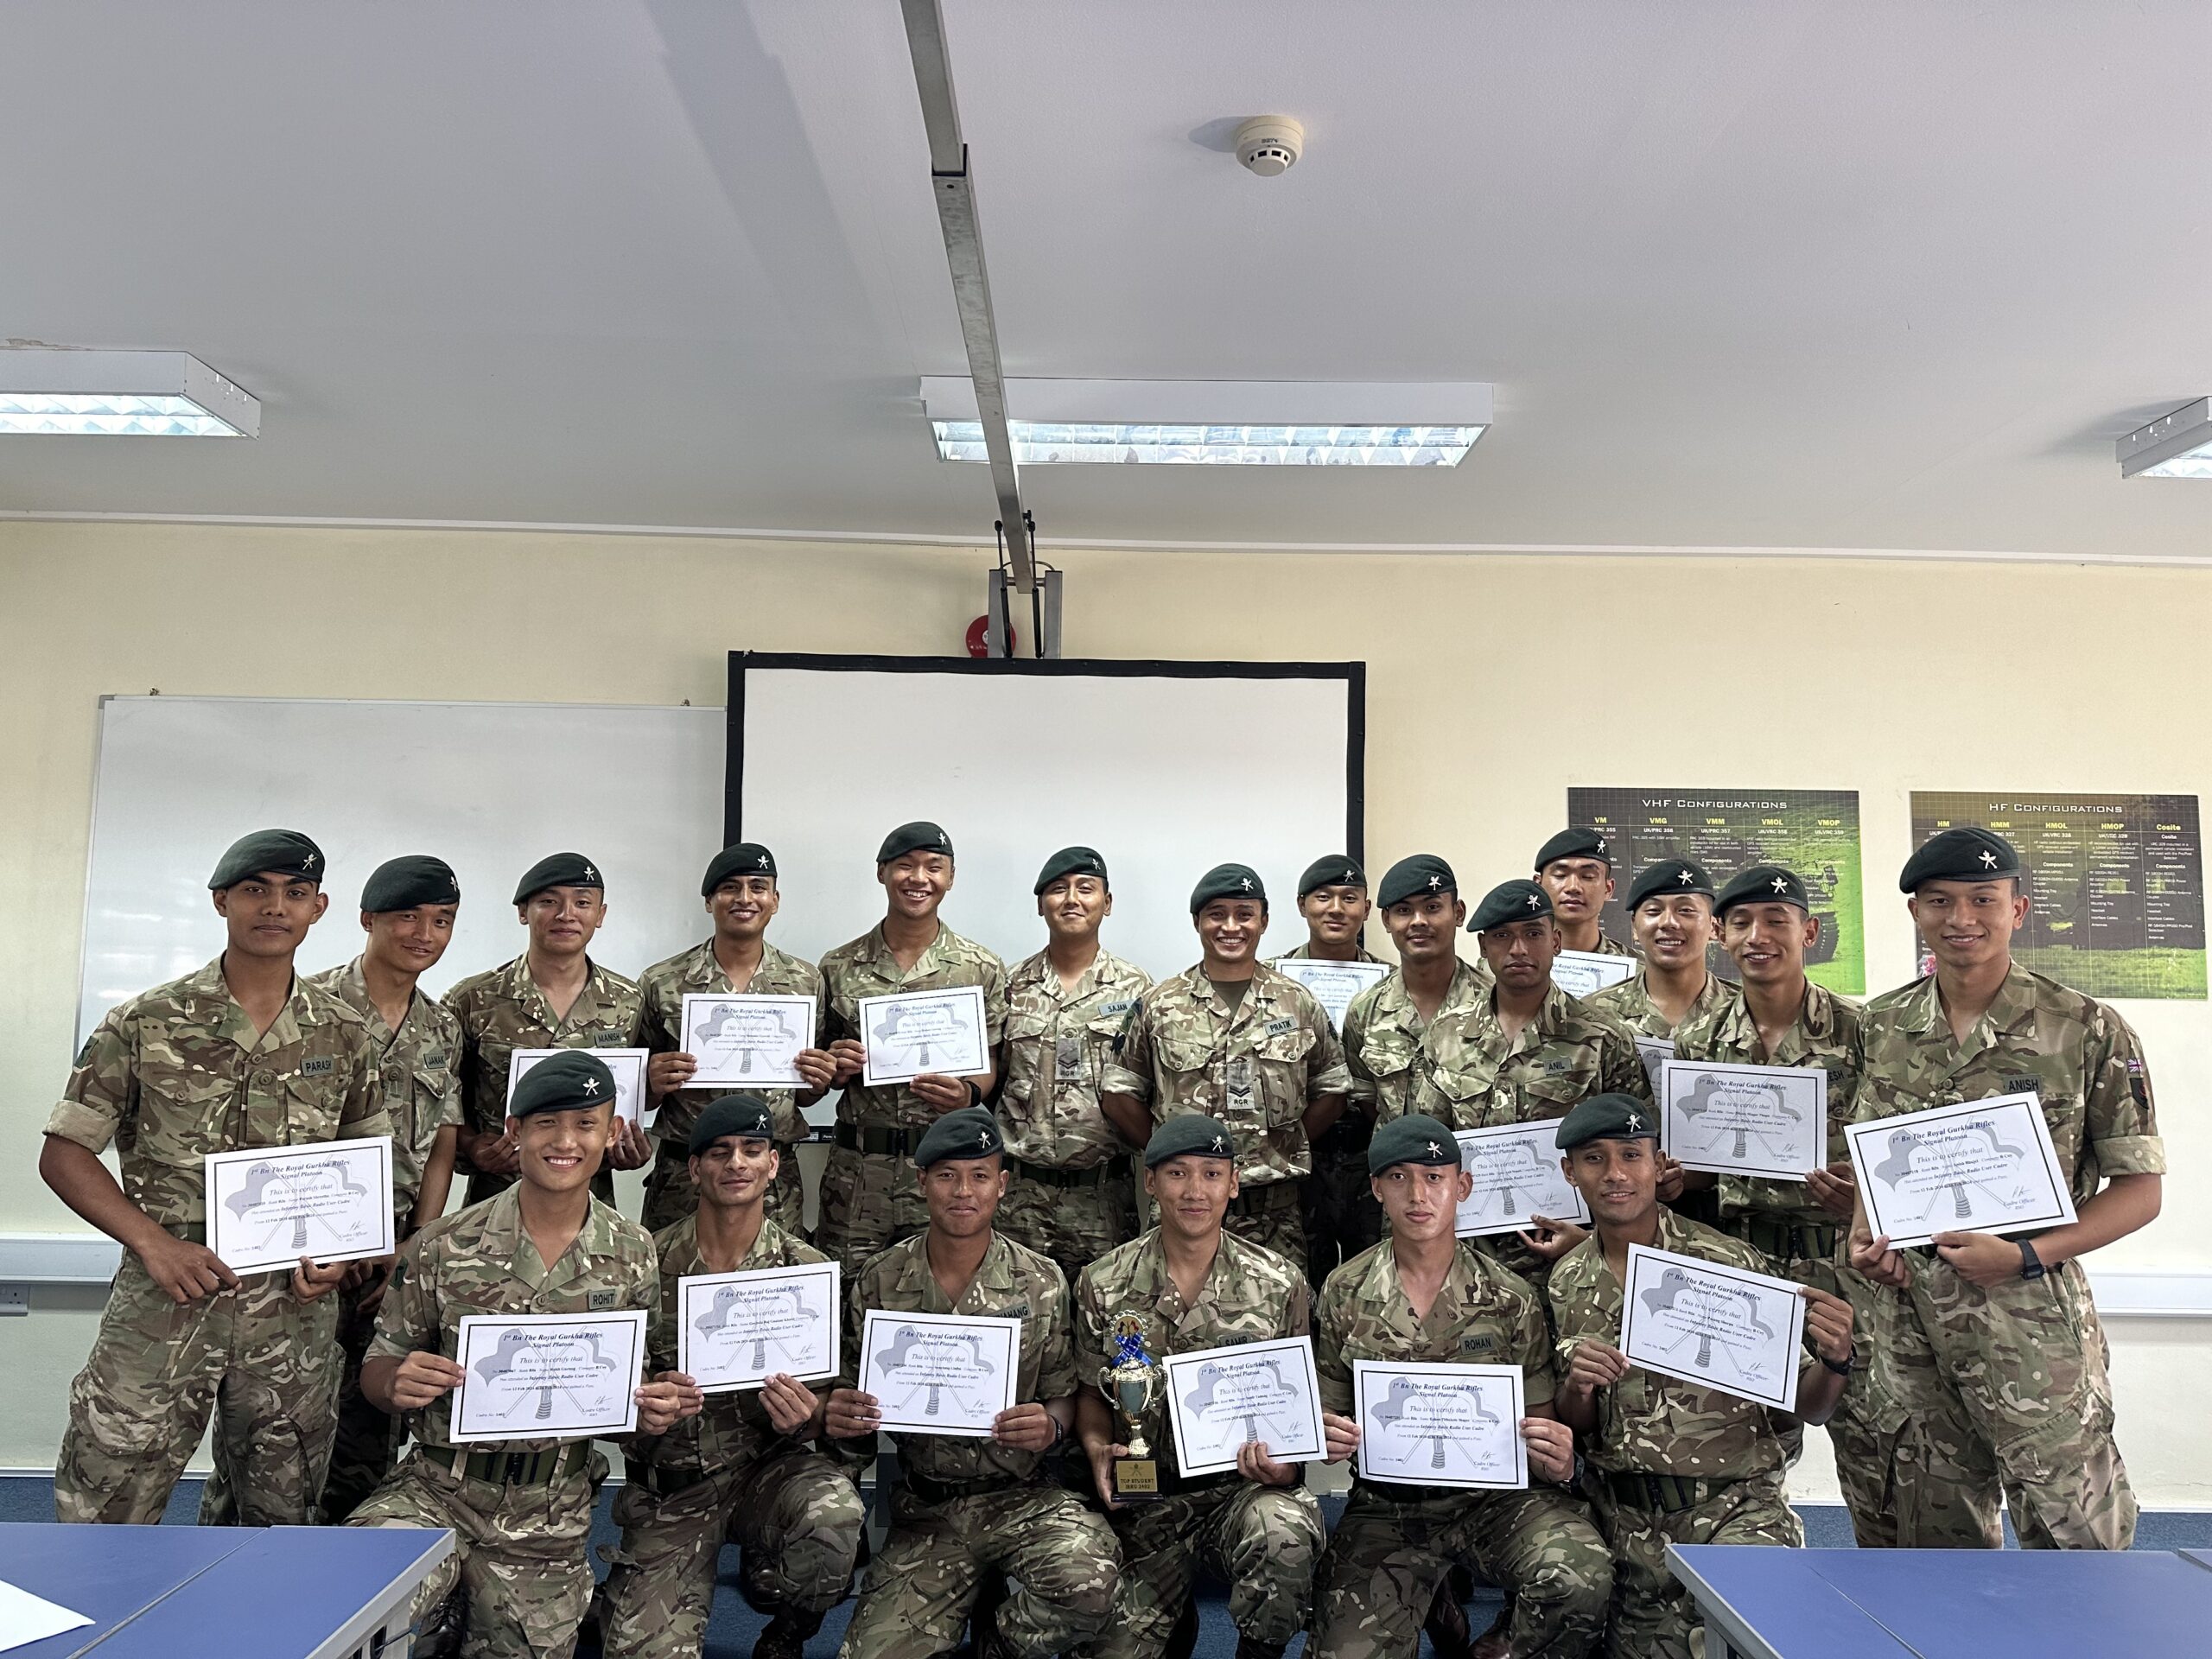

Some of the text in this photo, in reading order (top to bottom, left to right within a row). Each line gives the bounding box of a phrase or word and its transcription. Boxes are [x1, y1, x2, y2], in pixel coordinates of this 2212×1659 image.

[1642, 799, 1672, 808] VHF
[1108, 1004, 1128, 1013] SAJAN
[1548, 1060, 1566, 1071] ANIL
[2008, 1079, 2040, 1091] ANISH
[1927, 1128, 1946, 1138] Royal
[286, 1164, 304, 1173] Royal
[1698, 1281, 1716, 1290] Royal
[593, 1294, 614, 1305] ROHIT
[1464, 1337, 1492, 1351] ROHAN
